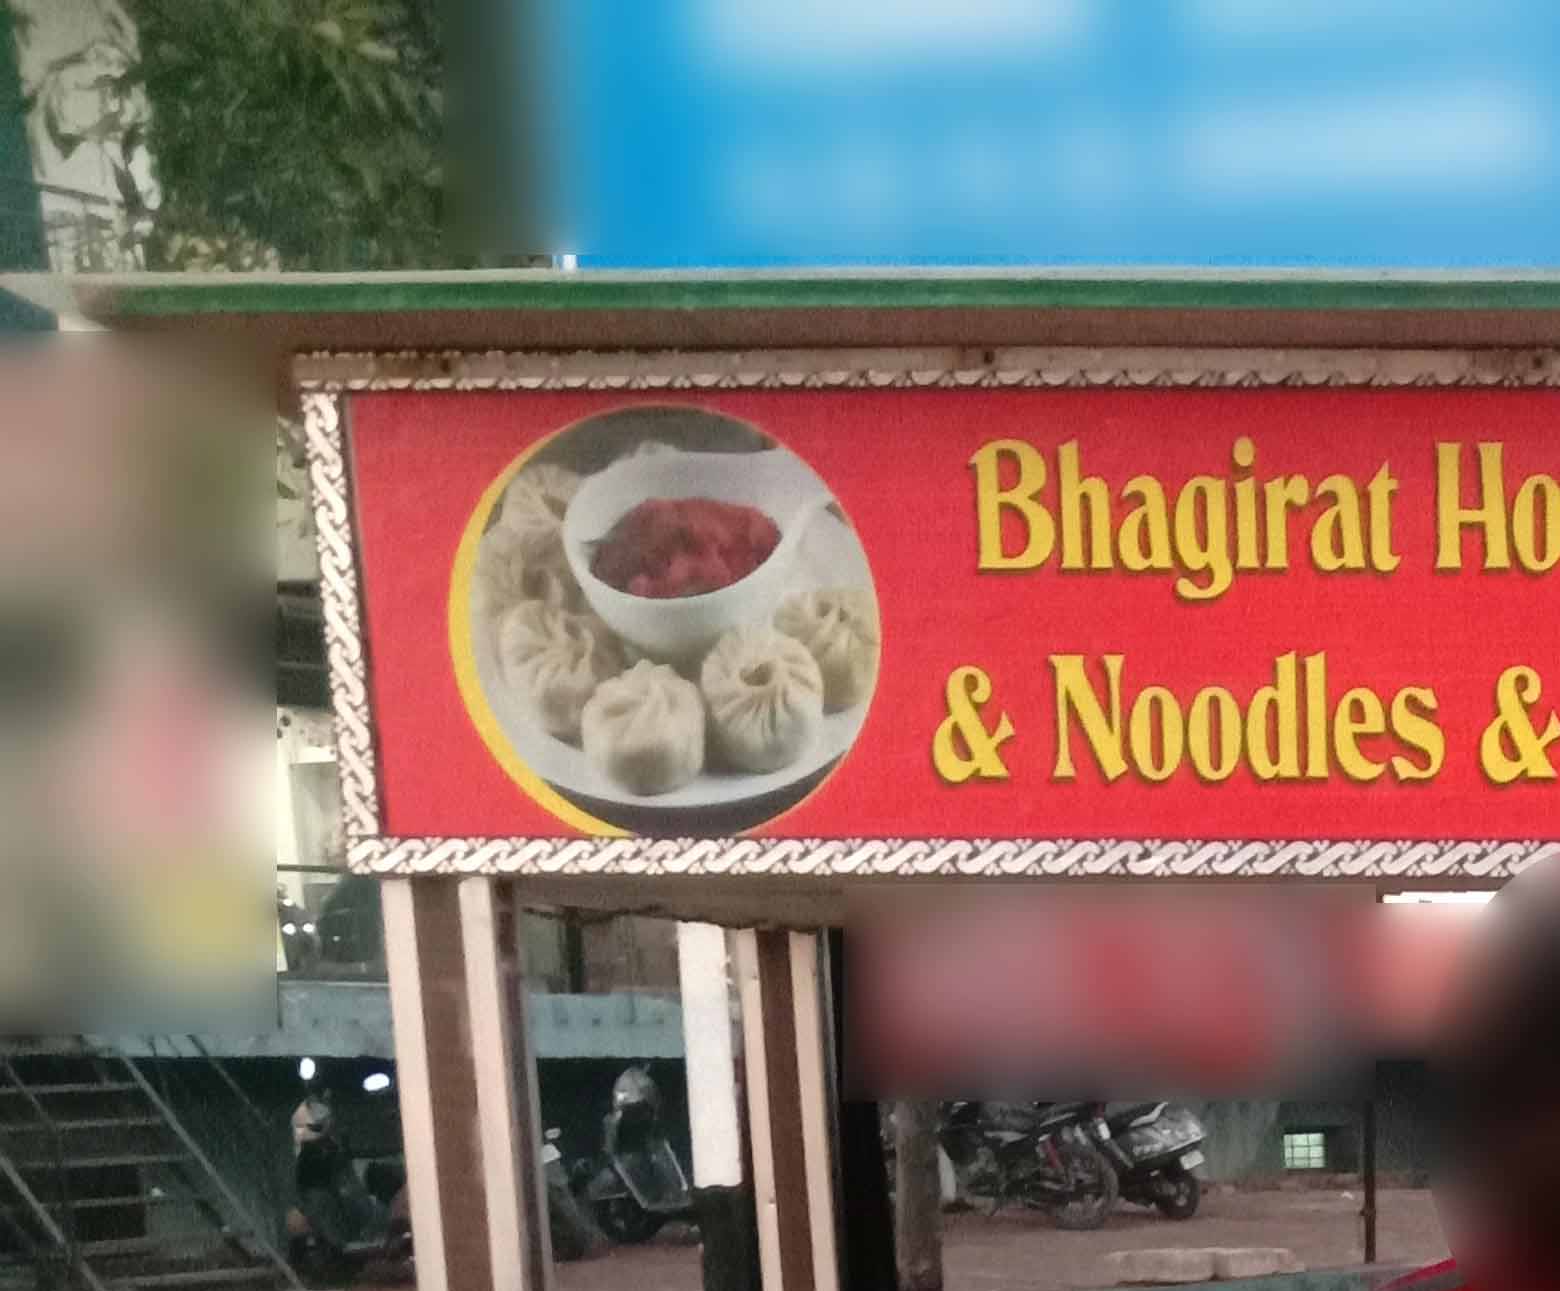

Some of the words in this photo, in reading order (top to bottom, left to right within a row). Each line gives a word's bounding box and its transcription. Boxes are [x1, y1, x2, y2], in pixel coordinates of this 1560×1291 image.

[972, 438, 1400, 601] Bhagirat
[932, 664, 1014, 784] &
[1048, 652, 1446, 785] Noodles
